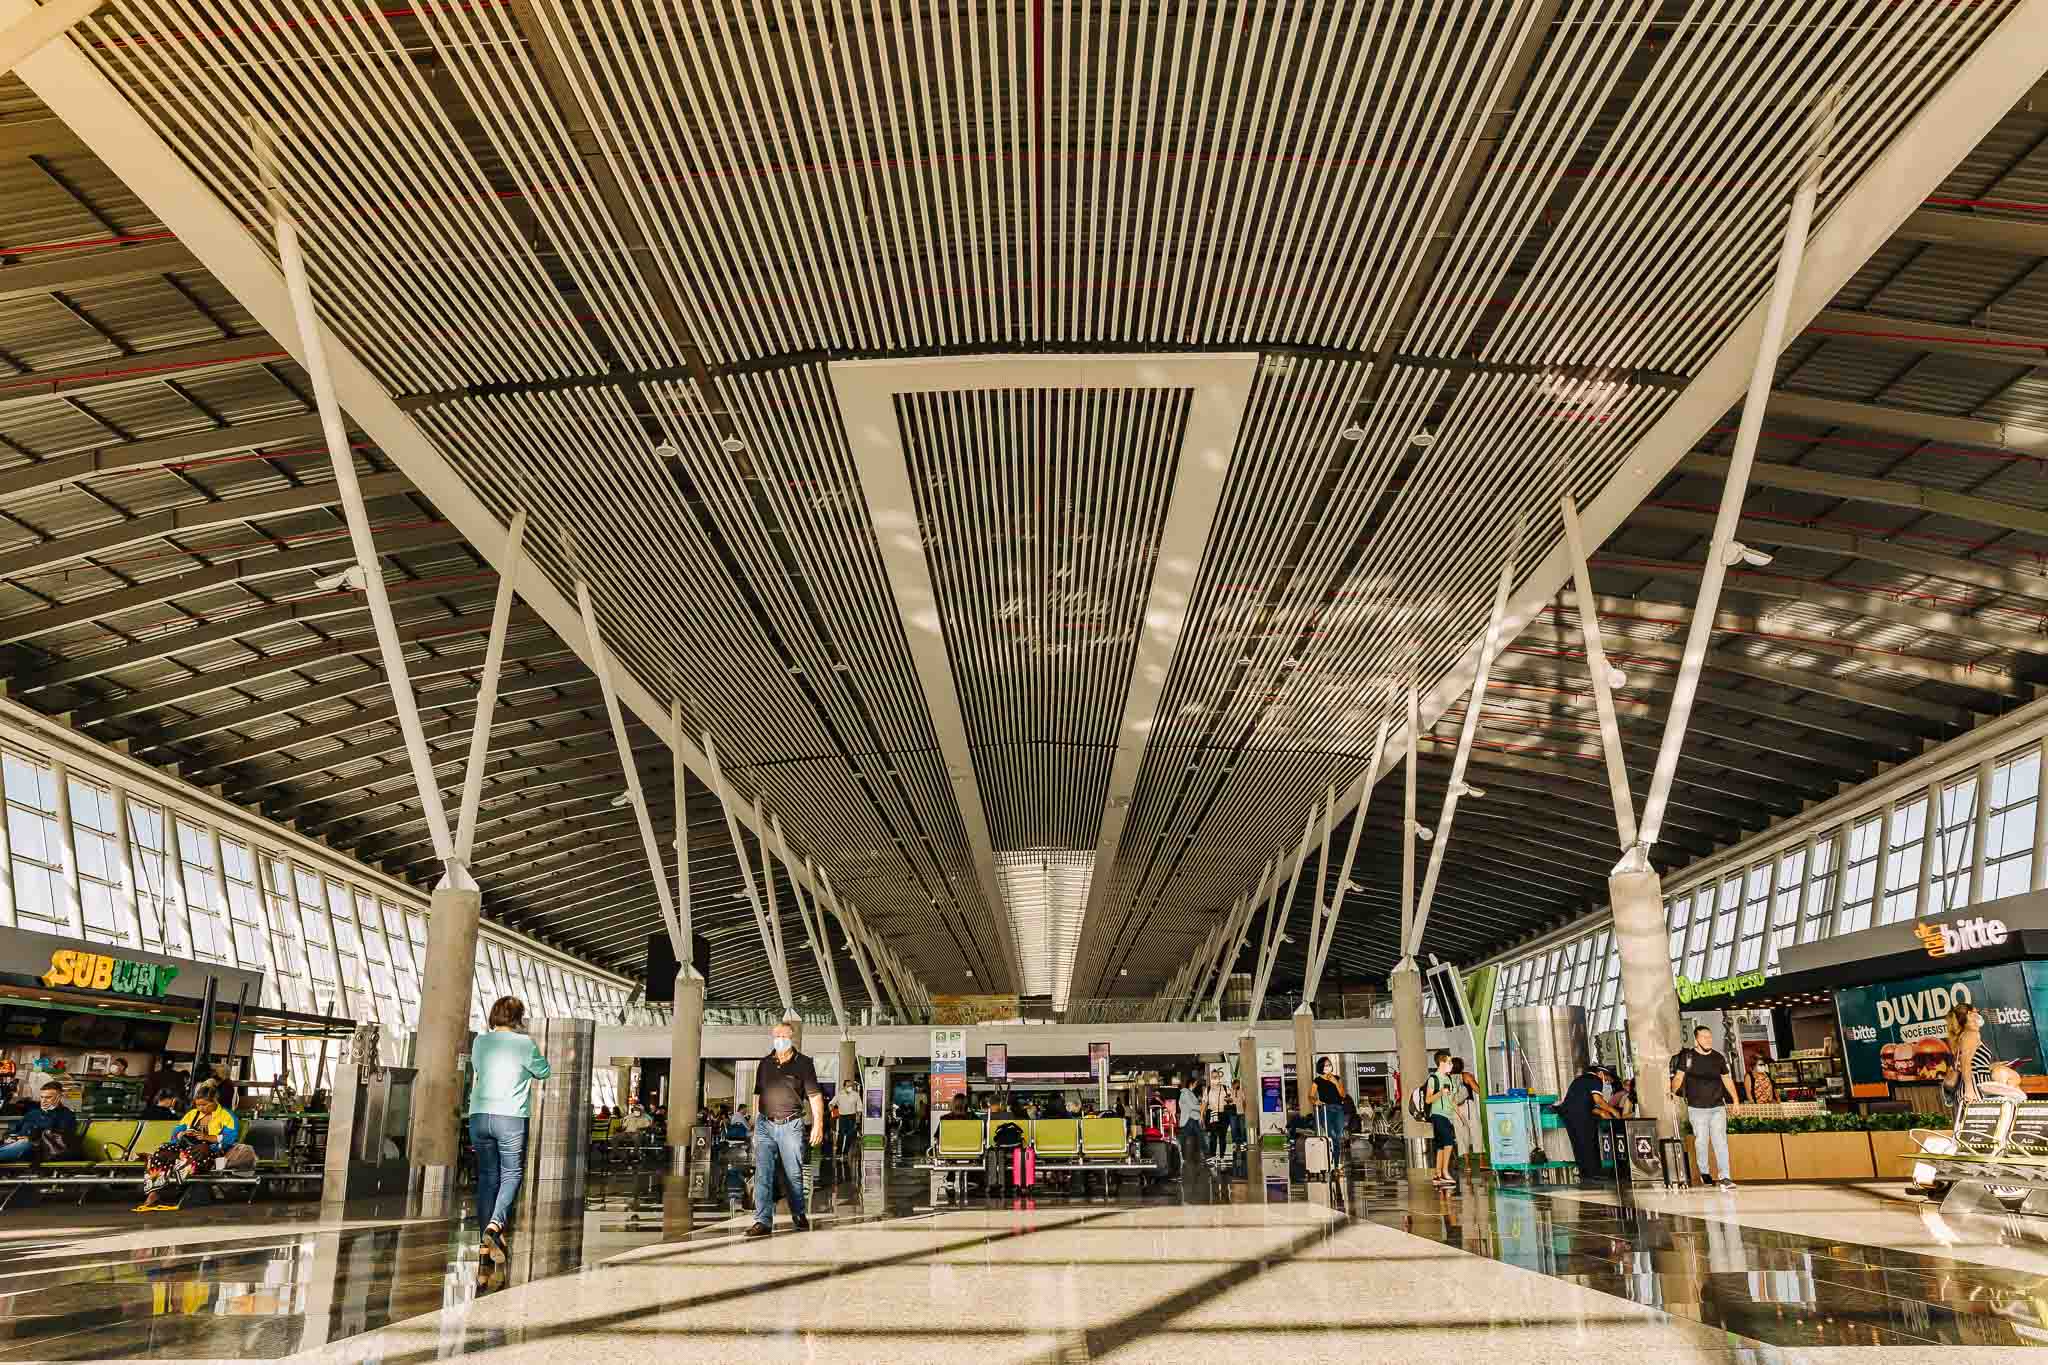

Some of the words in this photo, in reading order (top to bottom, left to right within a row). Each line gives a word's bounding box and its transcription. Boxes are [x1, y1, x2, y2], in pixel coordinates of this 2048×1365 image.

[1941, 917, 2008, 954] bitte
[43, 950, 181, 998] SUBWAY
[1876, 982, 1972, 1028] DUVIDO
[1996, 1006, 2030, 1024] bitte
[1852, 1025, 1877, 1040] bitte
[1923, 1024, 1948, 1036] RESIST
